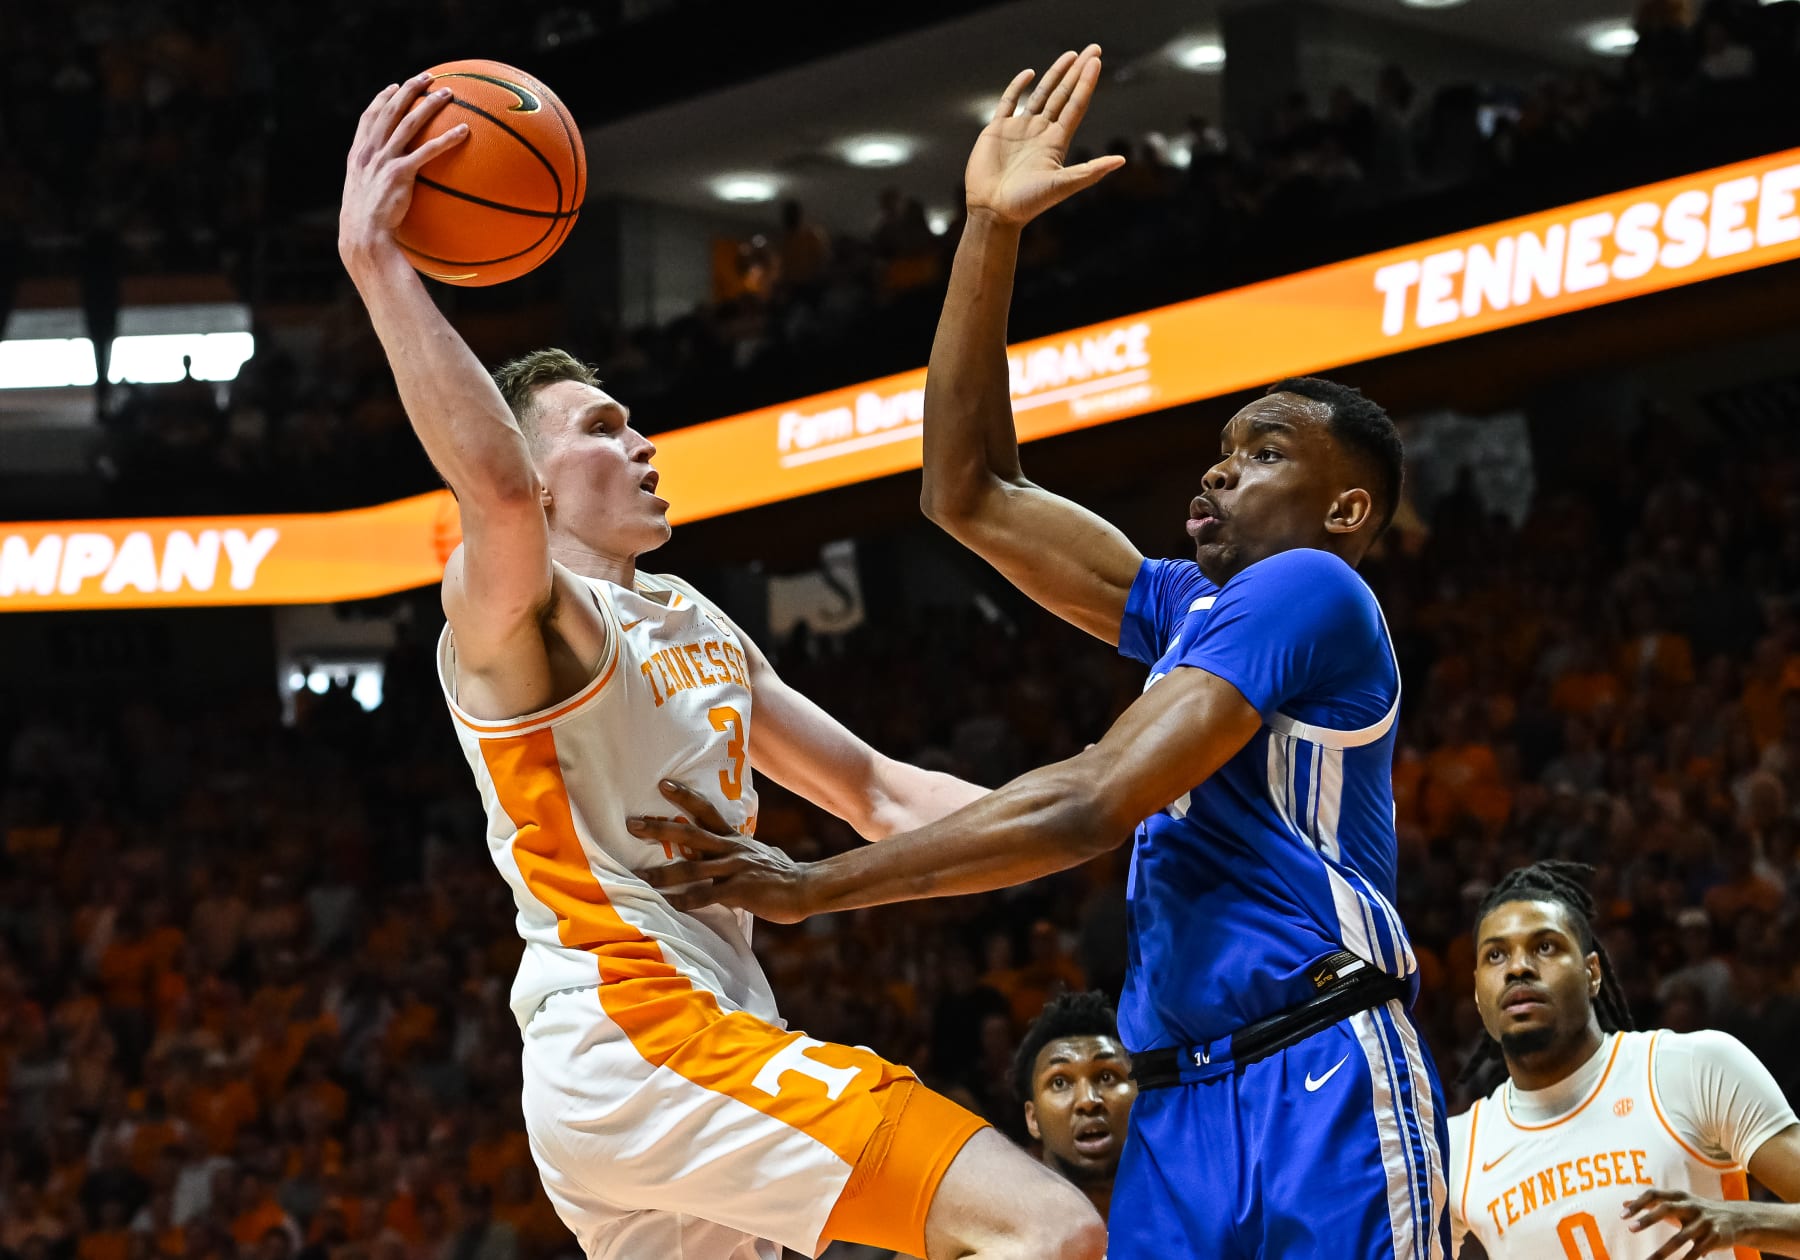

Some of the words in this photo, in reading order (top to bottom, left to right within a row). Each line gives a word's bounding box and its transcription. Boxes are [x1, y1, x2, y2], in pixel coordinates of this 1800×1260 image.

[1374, 164, 1800, 337] TENNESSEE
[0, 528, 279, 597] MPANY
[640, 641, 751, 708] TENNESSE
[708, 706, 745, 800] 3
[751, 1035, 862, 1101] T
[1487, 1149, 1654, 1237] TENNESSEE
[1556, 1211, 1610, 1260] 0
